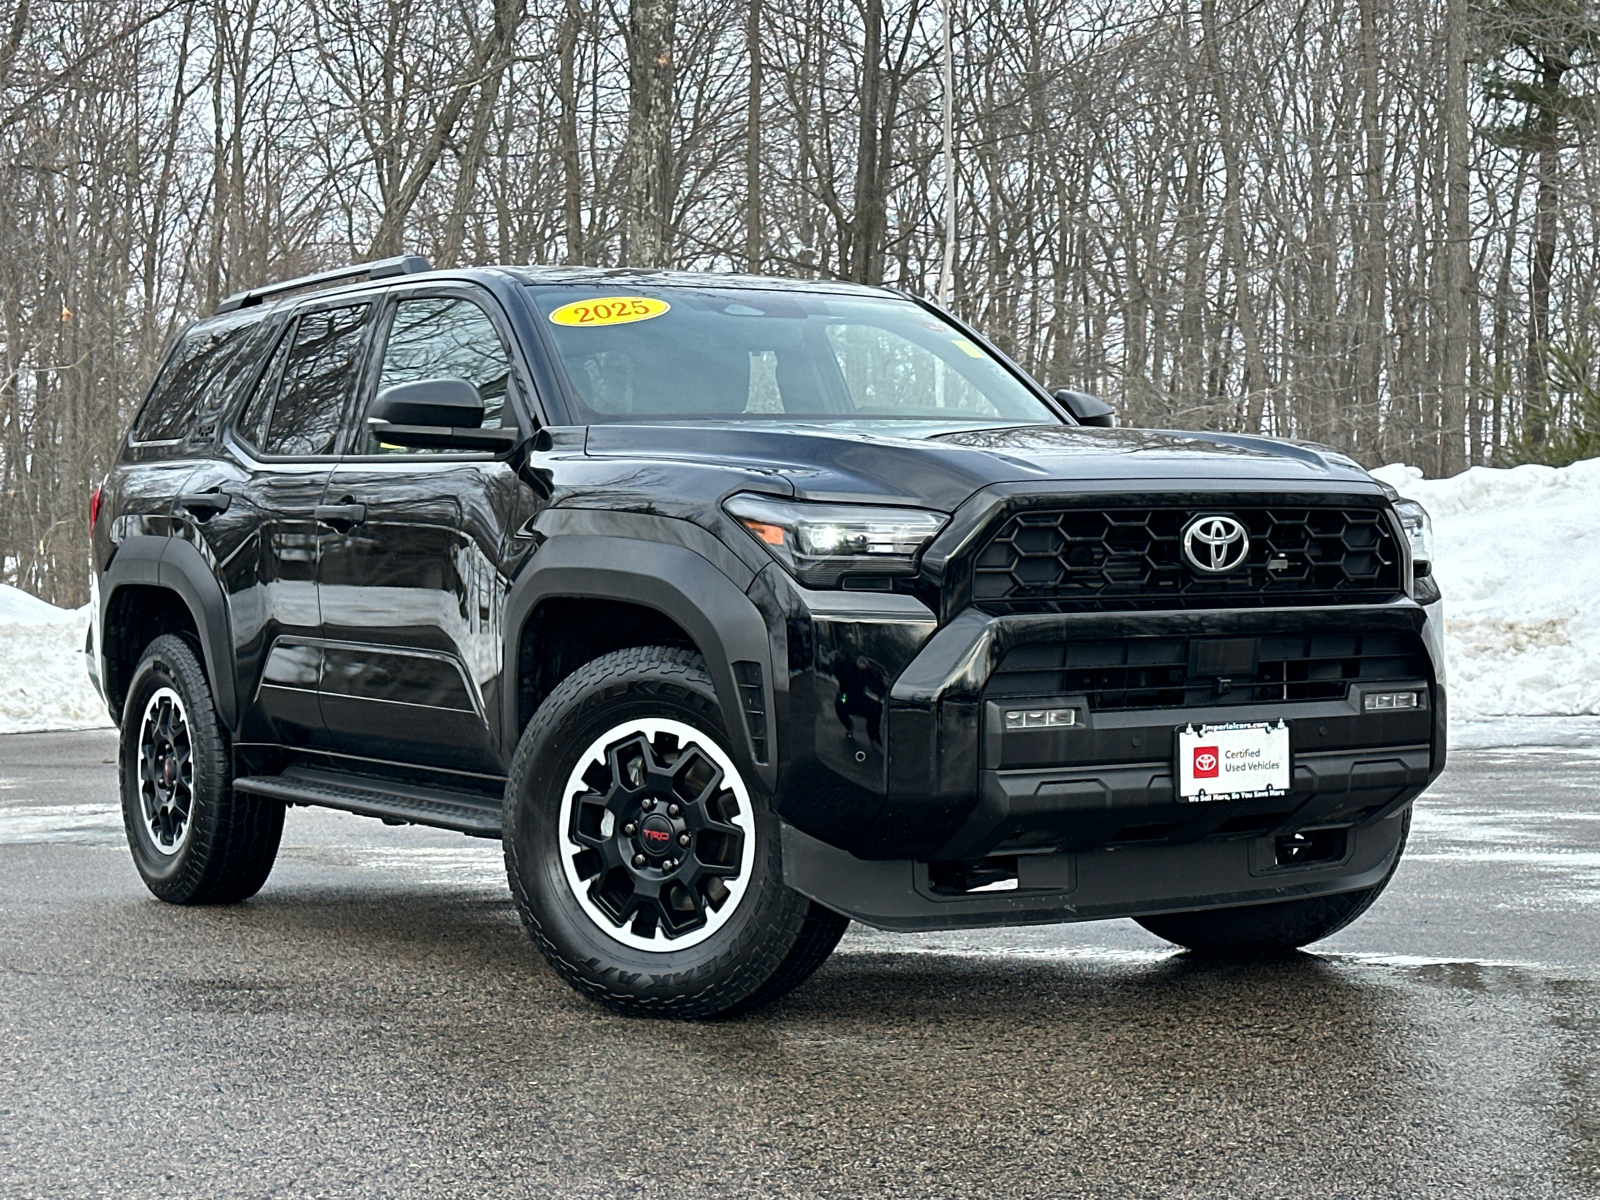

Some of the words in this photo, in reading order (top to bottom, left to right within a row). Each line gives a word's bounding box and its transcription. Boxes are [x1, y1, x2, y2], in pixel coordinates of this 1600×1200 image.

[574, 300, 650, 323] 2025
[1225, 748, 1261, 759] Certified
[1225, 762, 1246, 772] Used
[1247, 760, 1280, 771] Vehicles
[1188, 795, 1199, 803] We
[1200, 794, 1212, 802] Sell
[1212, 792, 1231, 801] More,
[1231, 791, 1240, 800] So
[1241, 791, 1253, 799] You
[1269, 789, 1285, 797] More
[643, 828, 670, 841] TRD
